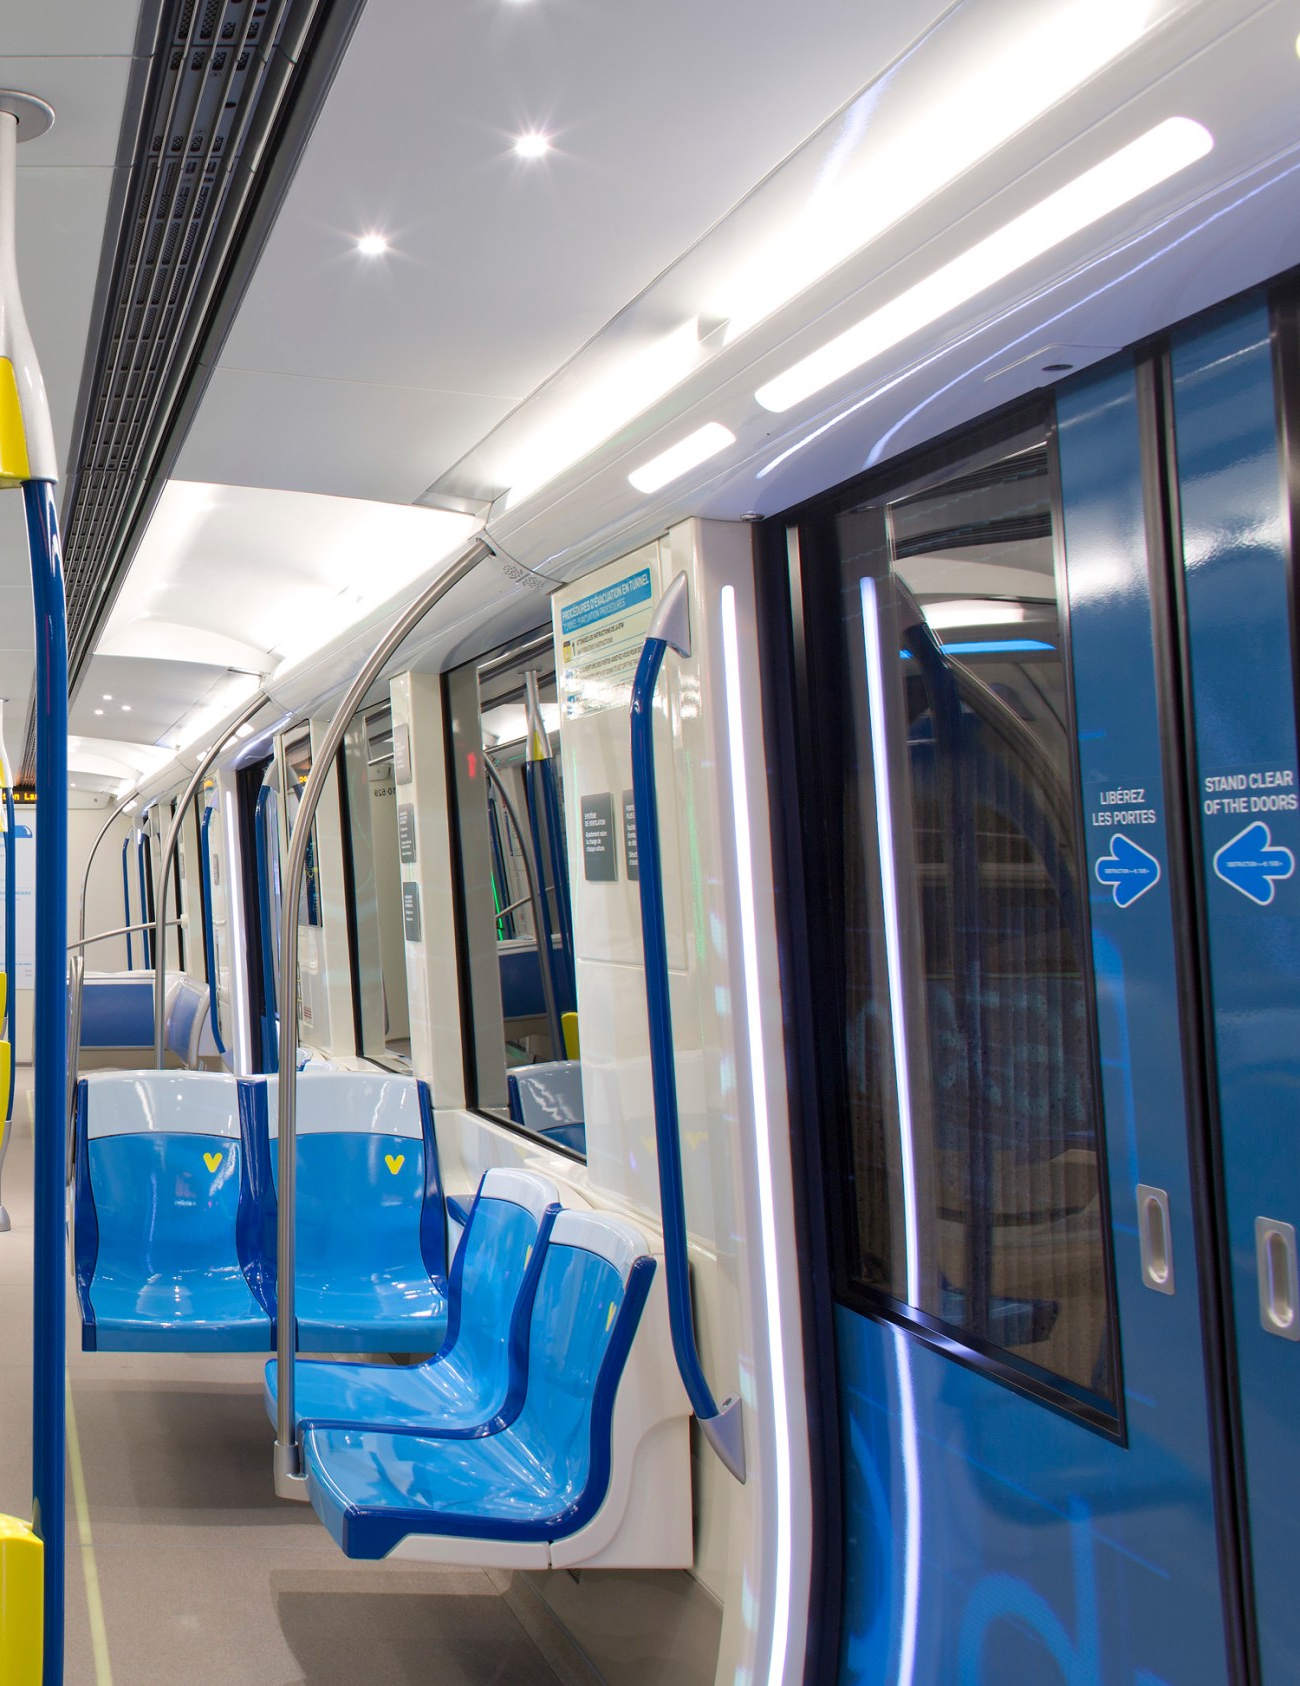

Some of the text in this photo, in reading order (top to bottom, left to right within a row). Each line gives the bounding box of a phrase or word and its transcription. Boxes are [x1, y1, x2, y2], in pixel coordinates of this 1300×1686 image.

[1205, 770, 1293, 792] STAND CLEAR
[1100, 787, 1145, 805] LIBÉREZ
[1204, 794, 1298, 815] OF THE DOORS
[1092, 810, 1156, 826] LES PORTES
